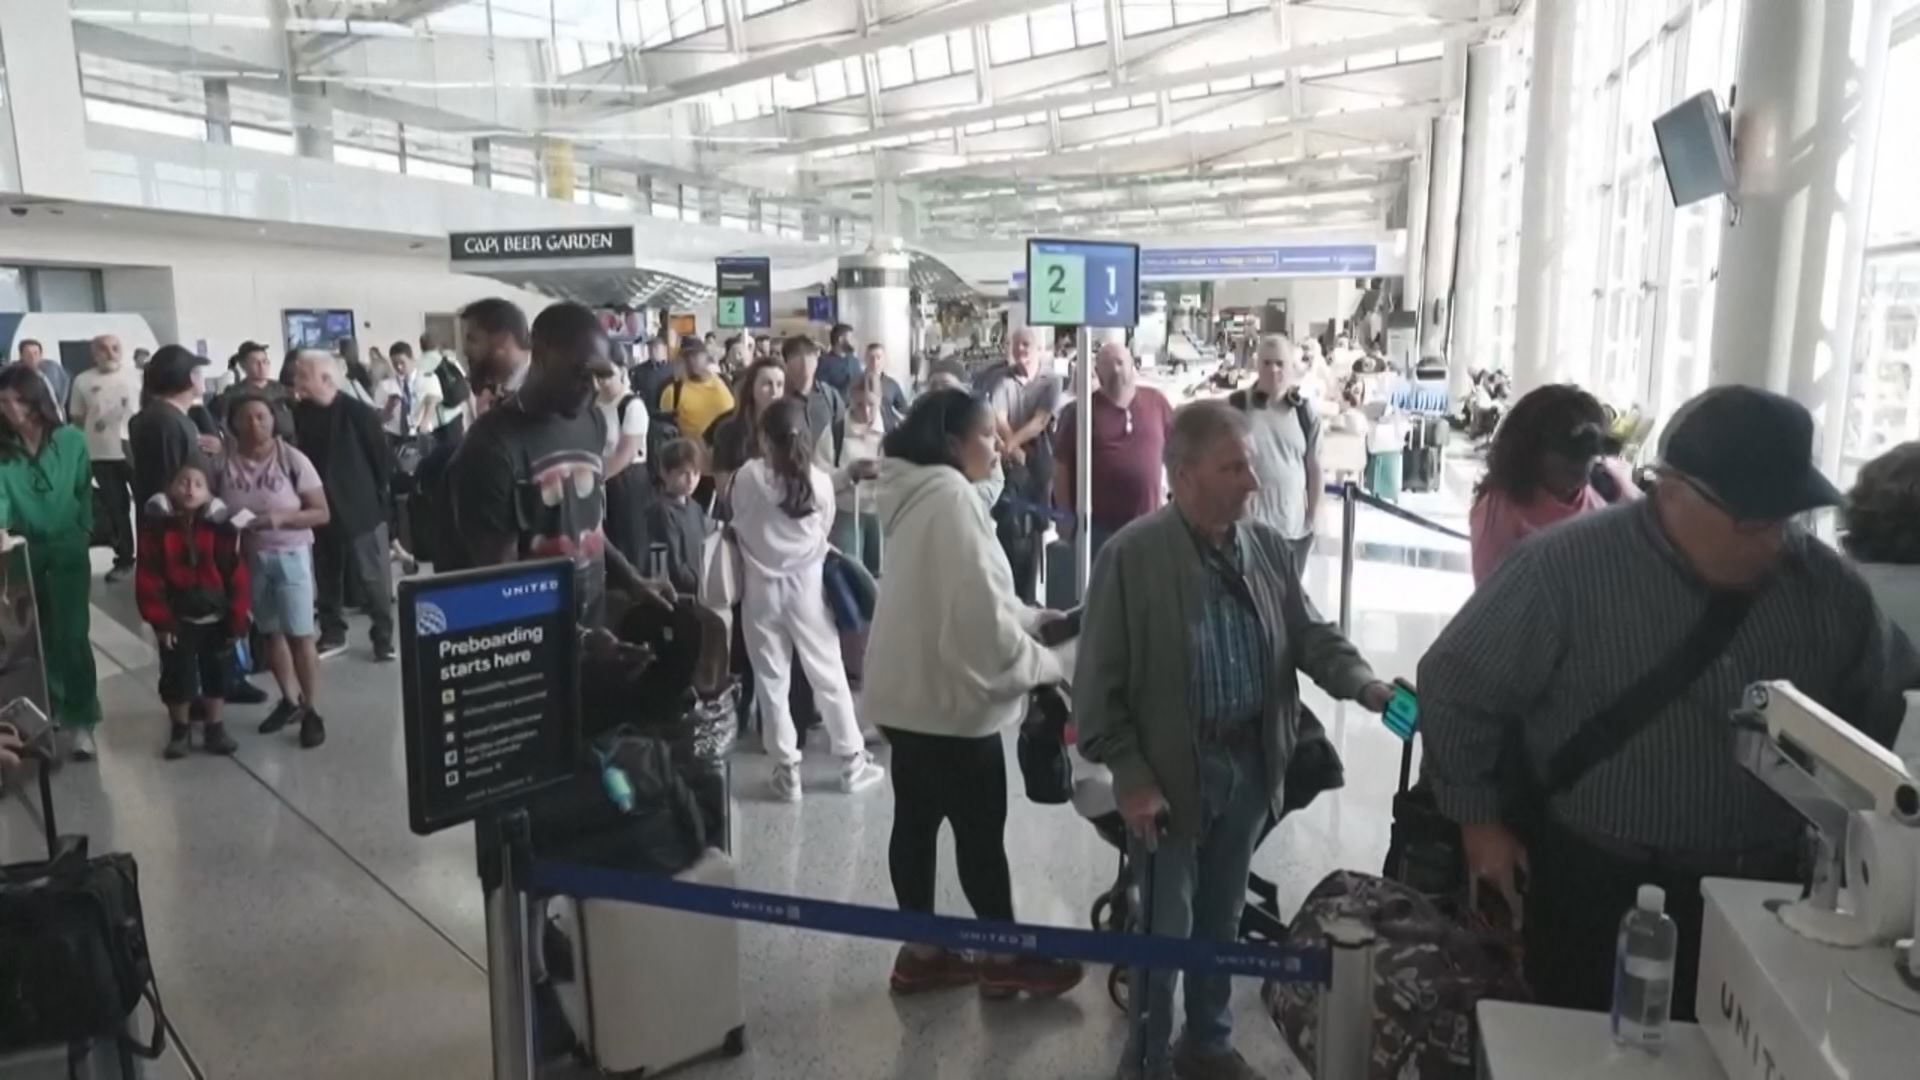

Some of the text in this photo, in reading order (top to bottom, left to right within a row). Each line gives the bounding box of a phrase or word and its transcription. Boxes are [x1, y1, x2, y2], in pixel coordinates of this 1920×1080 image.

[503, 234, 542, 252] BEER
[546, 232, 613, 251] GARDEN
[1047, 264, 1066, 294] 2
[1105, 266, 1117, 296] 1
[727, 301, 736, 314] 2
[502, 580, 559, 598] UNITED
[439, 626, 543, 658] Preboarding
[440, 649, 532, 681] starts here
[732, 899, 785, 916] UNITED
[959, 930, 1019, 945] UNITED
[1721, 981, 1786, 1080] UNIT
